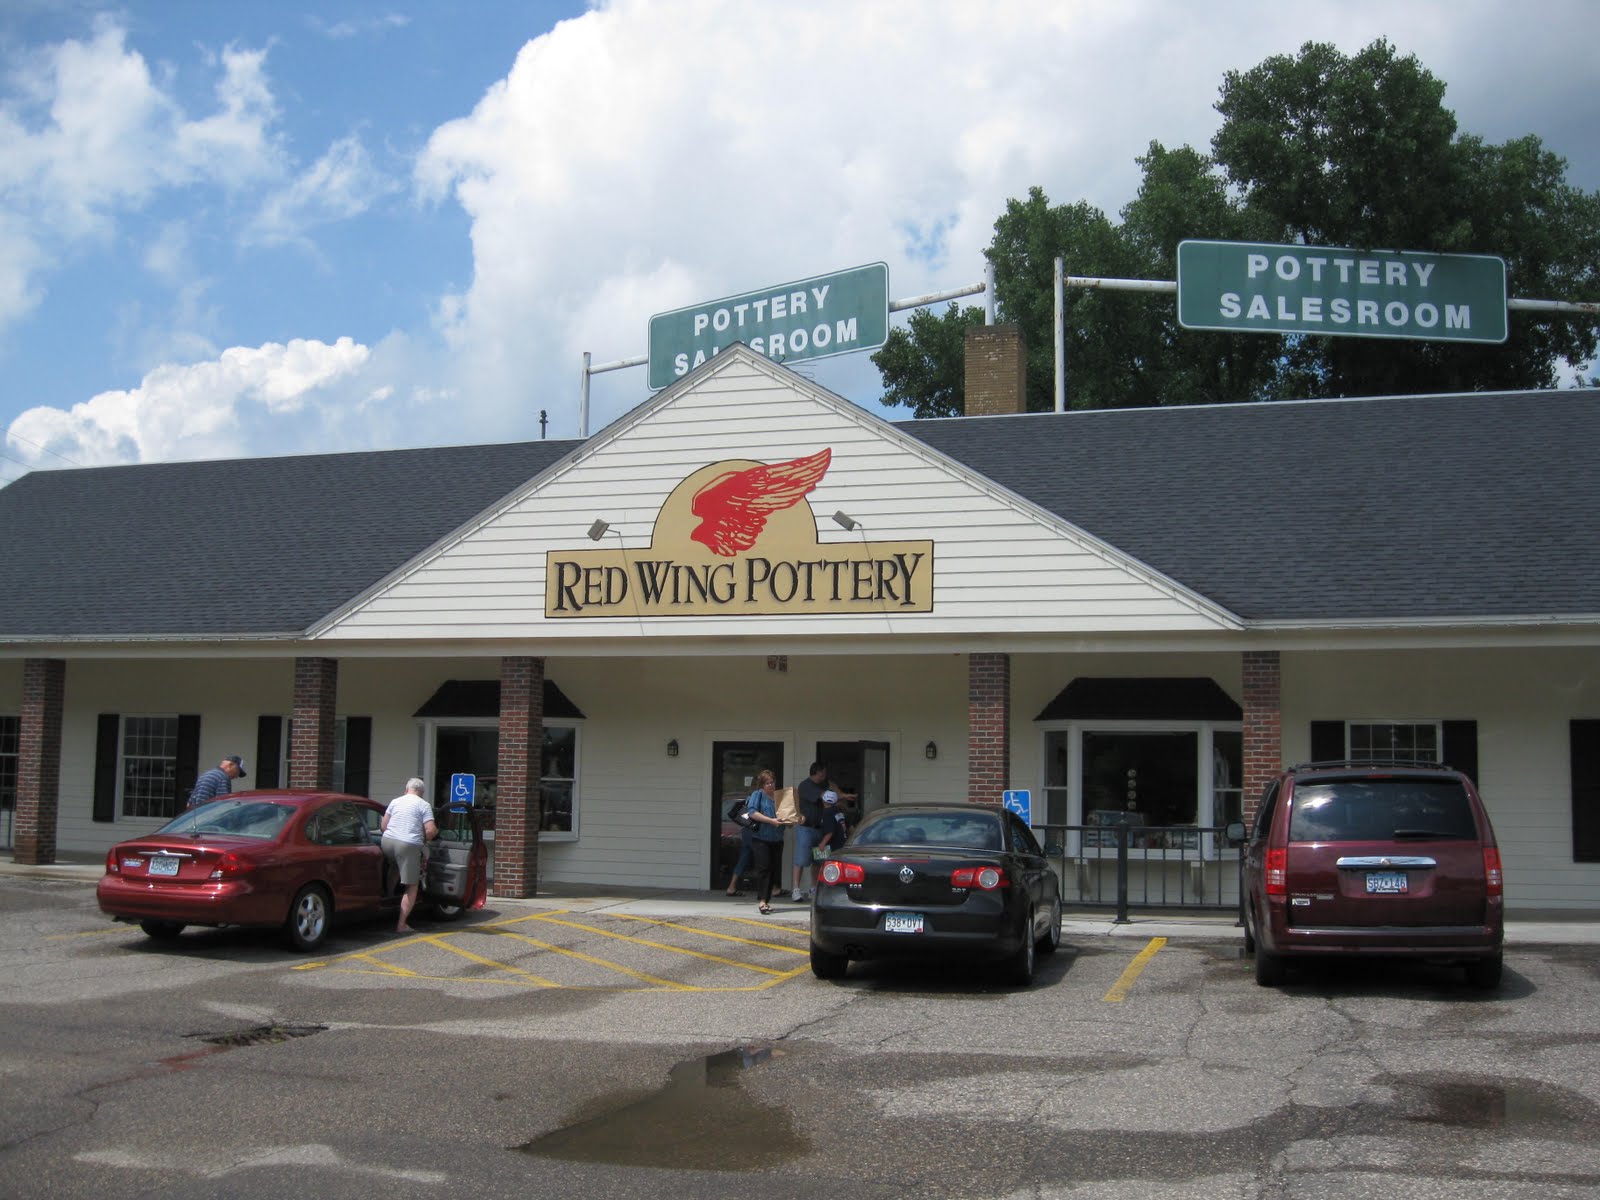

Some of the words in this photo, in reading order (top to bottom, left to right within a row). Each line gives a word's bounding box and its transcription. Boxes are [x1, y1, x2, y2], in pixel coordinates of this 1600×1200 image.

[1247, 254, 1434, 287] POTTERY
[694, 285, 830, 336] POTTERY
[1219, 293, 1471, 329] SALESROOM
[674, 318, 857, 375] SASROOM
[553, 561, 629, 611] RED
[634, 560, 737, 605] WING
[744, 553, 925, 607] POTTERY
